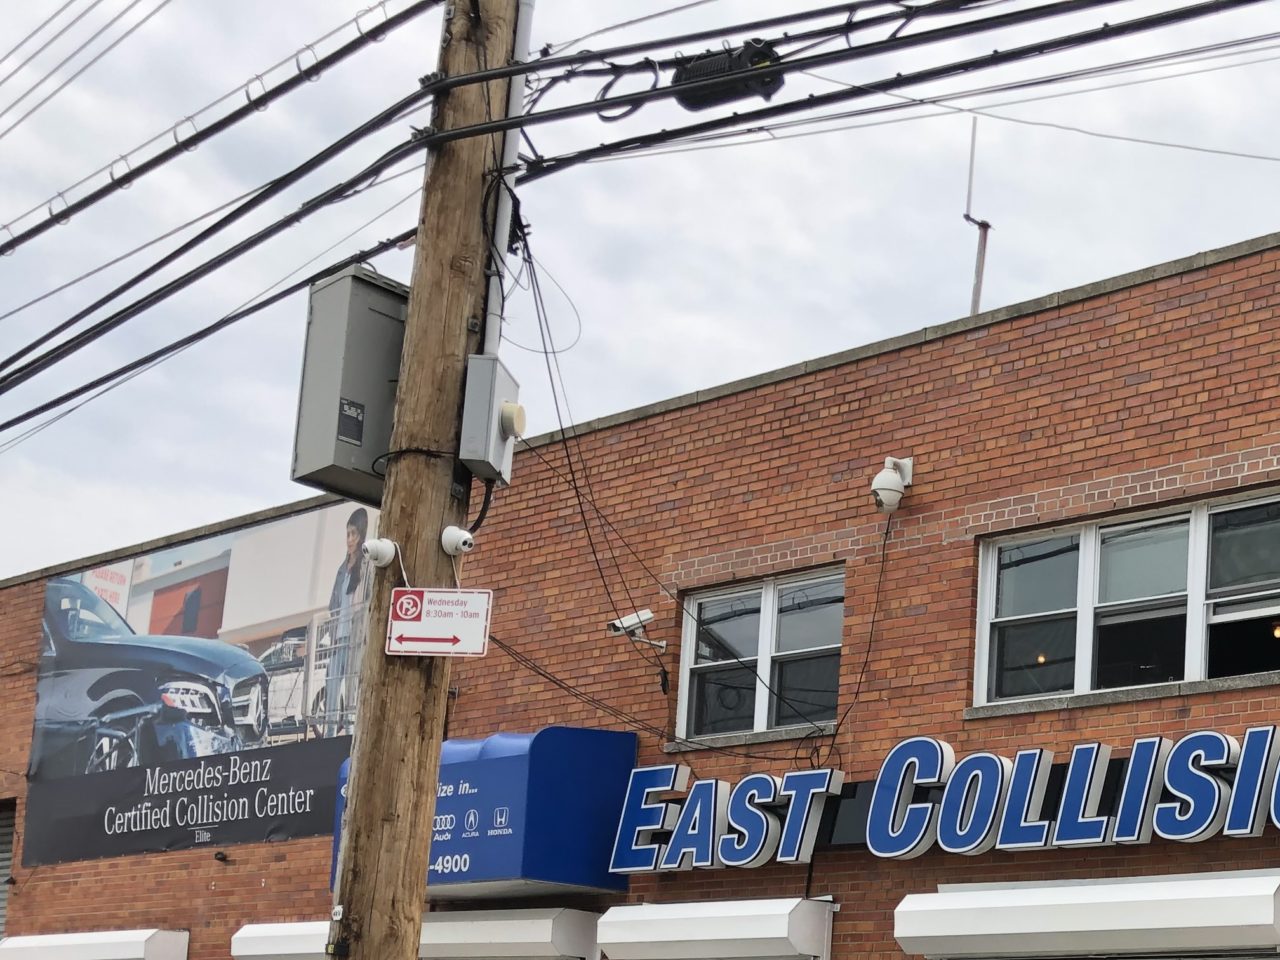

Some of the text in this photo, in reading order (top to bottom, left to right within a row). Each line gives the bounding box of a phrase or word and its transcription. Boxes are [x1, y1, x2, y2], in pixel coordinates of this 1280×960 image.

[427, 598, 468, 608] Wednesday
[461, 611, 480, 619] 10am
[144, 755, 272, 797] Mercedes-Benz
[104, 786, 315, 835] Certified Collision Center
[609, 764, 842, 874] EAST
[195, 830, 211, 843] Elite
[433, 832, 451, 841] Audi
[487, 828, 513, 836] HONDA
